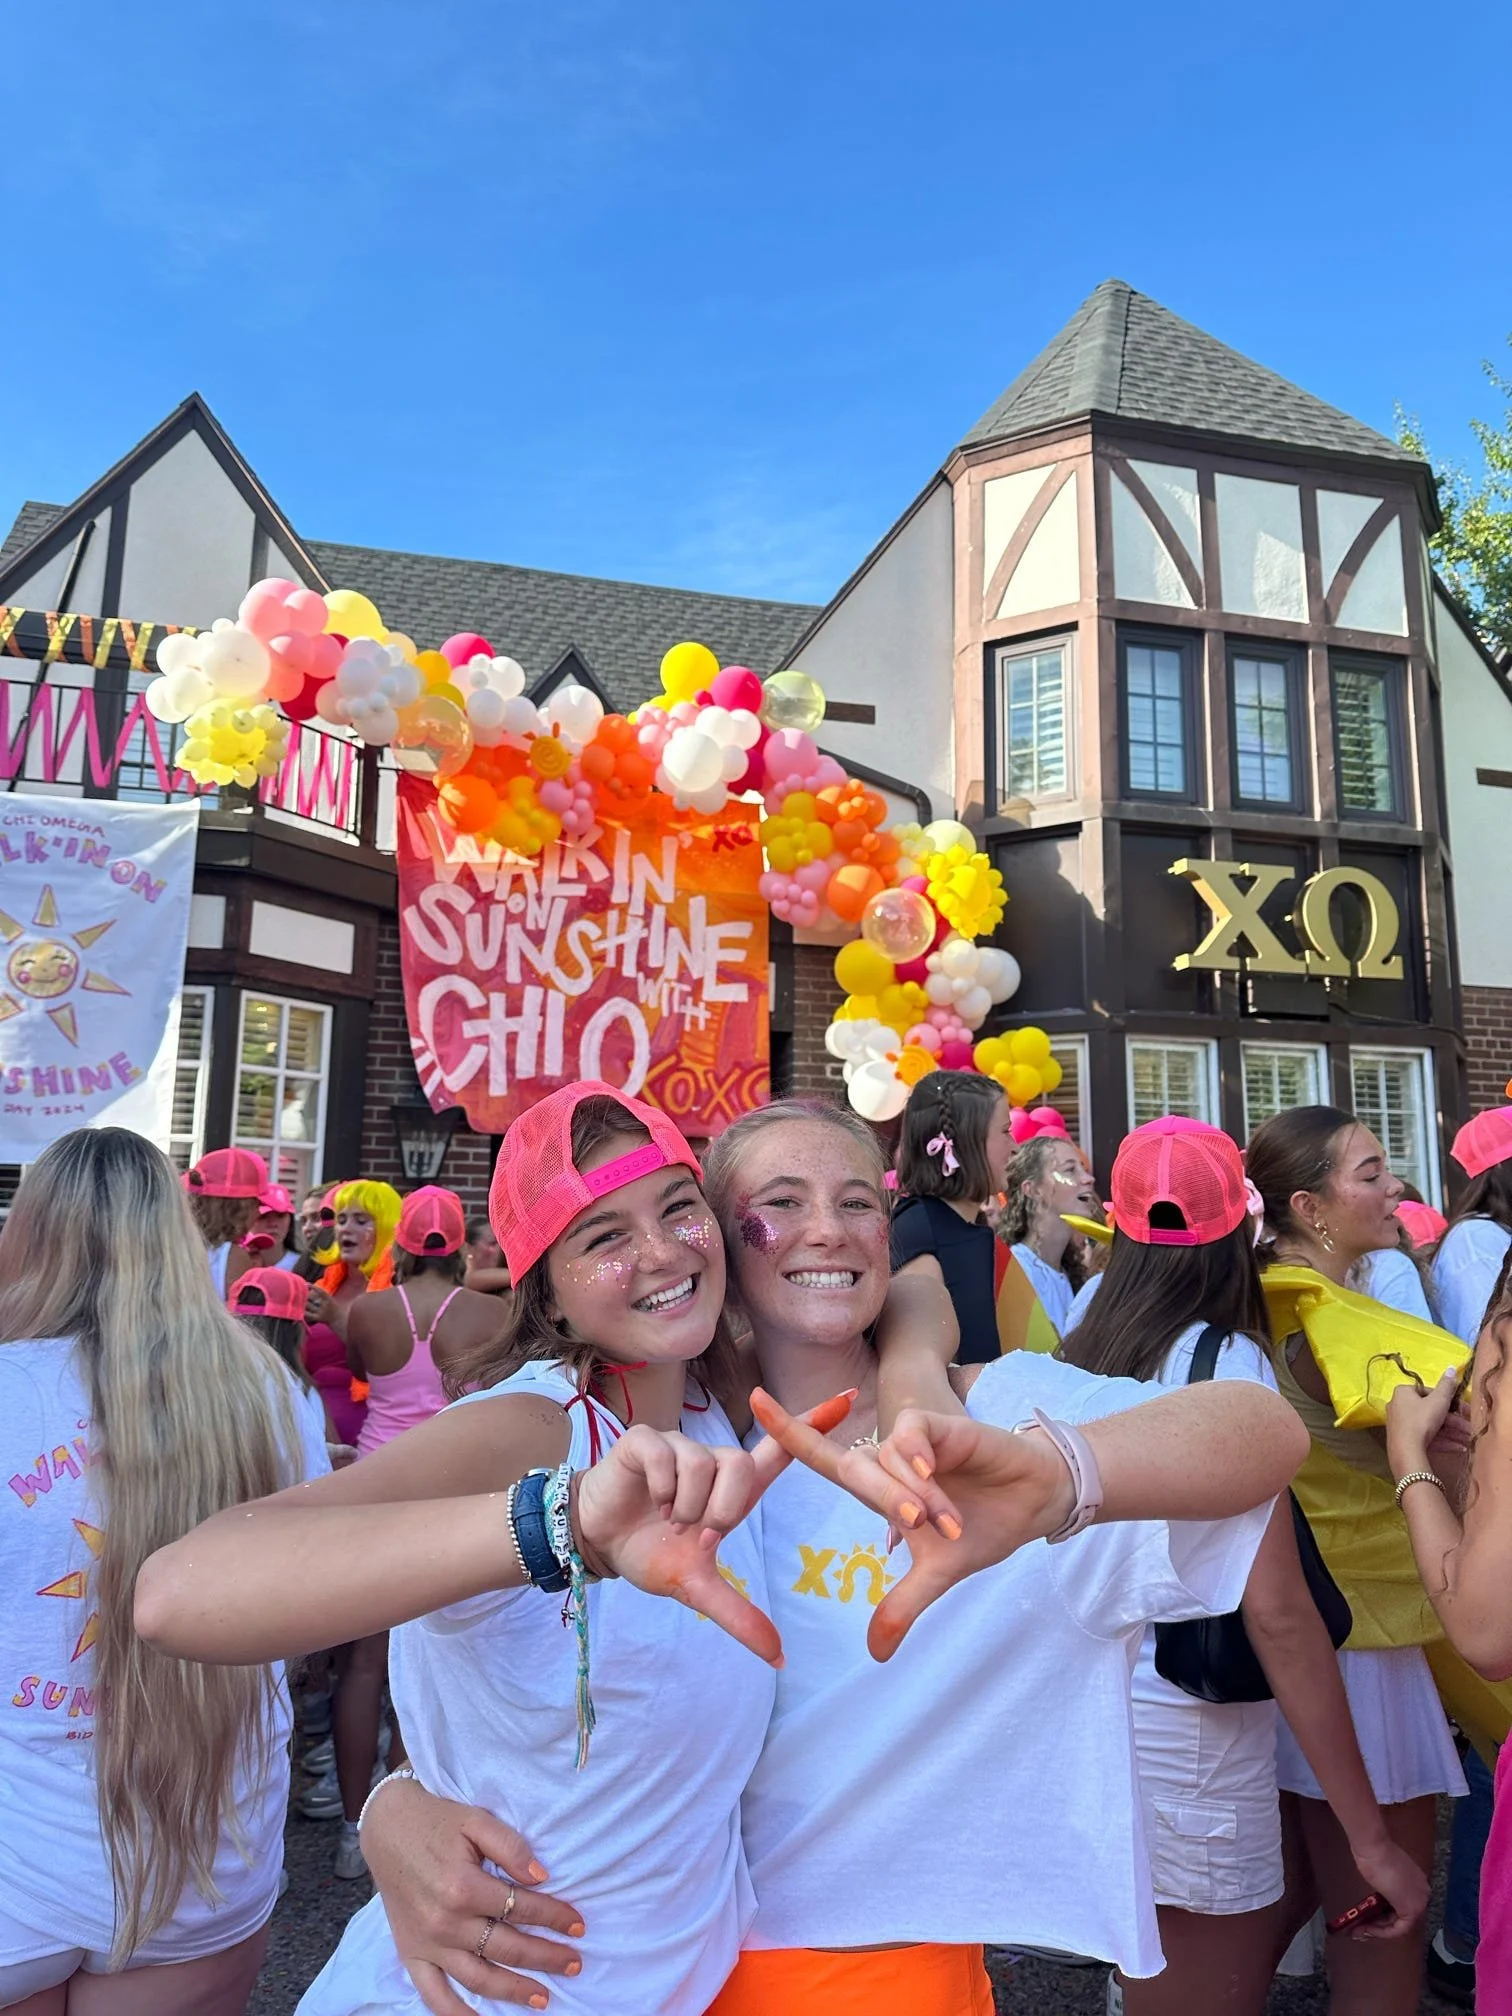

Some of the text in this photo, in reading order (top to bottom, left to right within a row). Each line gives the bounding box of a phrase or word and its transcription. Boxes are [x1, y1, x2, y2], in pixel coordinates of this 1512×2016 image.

[3, 815, 105, 838] CHI OMEGA
[0, 831, 168, 903] LK'IN ON
[403, 881, 754, 1003] SUNSHINE
[638, 972, 711, 1032] WITH
[0, 1051, 142, 1098] SHINE
[8, 1436, 95, 1508] WAL
[12, 1676, 97, 1717] SUN
